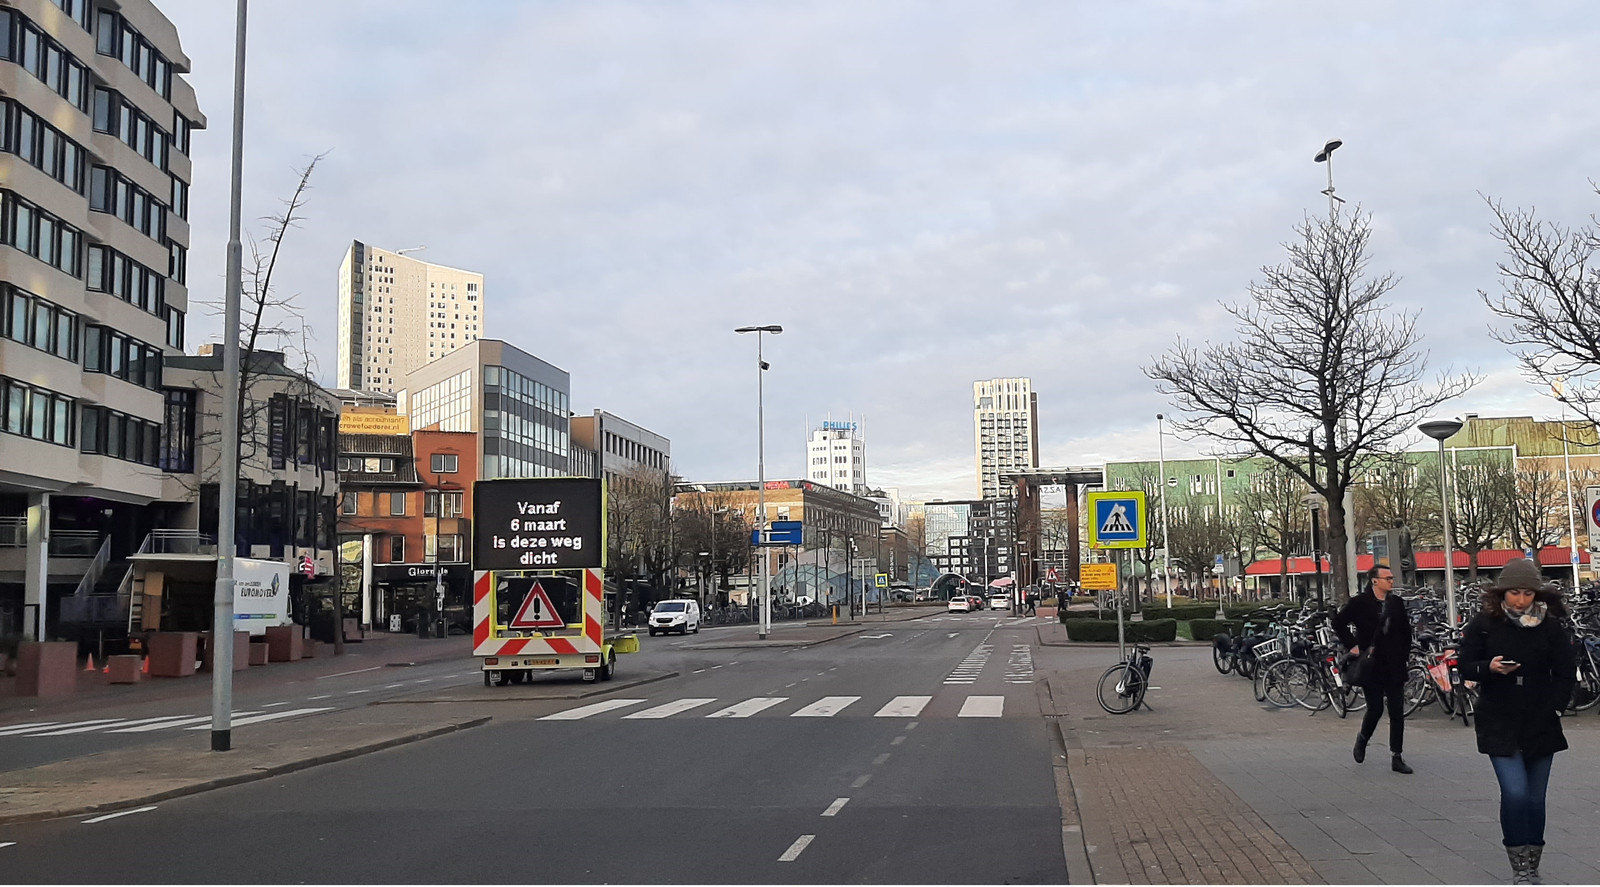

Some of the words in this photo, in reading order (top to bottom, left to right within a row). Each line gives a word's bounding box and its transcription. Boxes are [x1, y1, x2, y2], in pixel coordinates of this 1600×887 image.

[823, 420, 857, 430] PHILIPS
[517, 501, 561, 514] Vanaf
[510, 518, 520, 531] 6
[524, 518, 567, 531] maart
[493, 535, 506, 548] is
[510, 535, 547, 548] deze
[551, 536, 582, 550] weg
[520, 551, 558, 564] dicht
